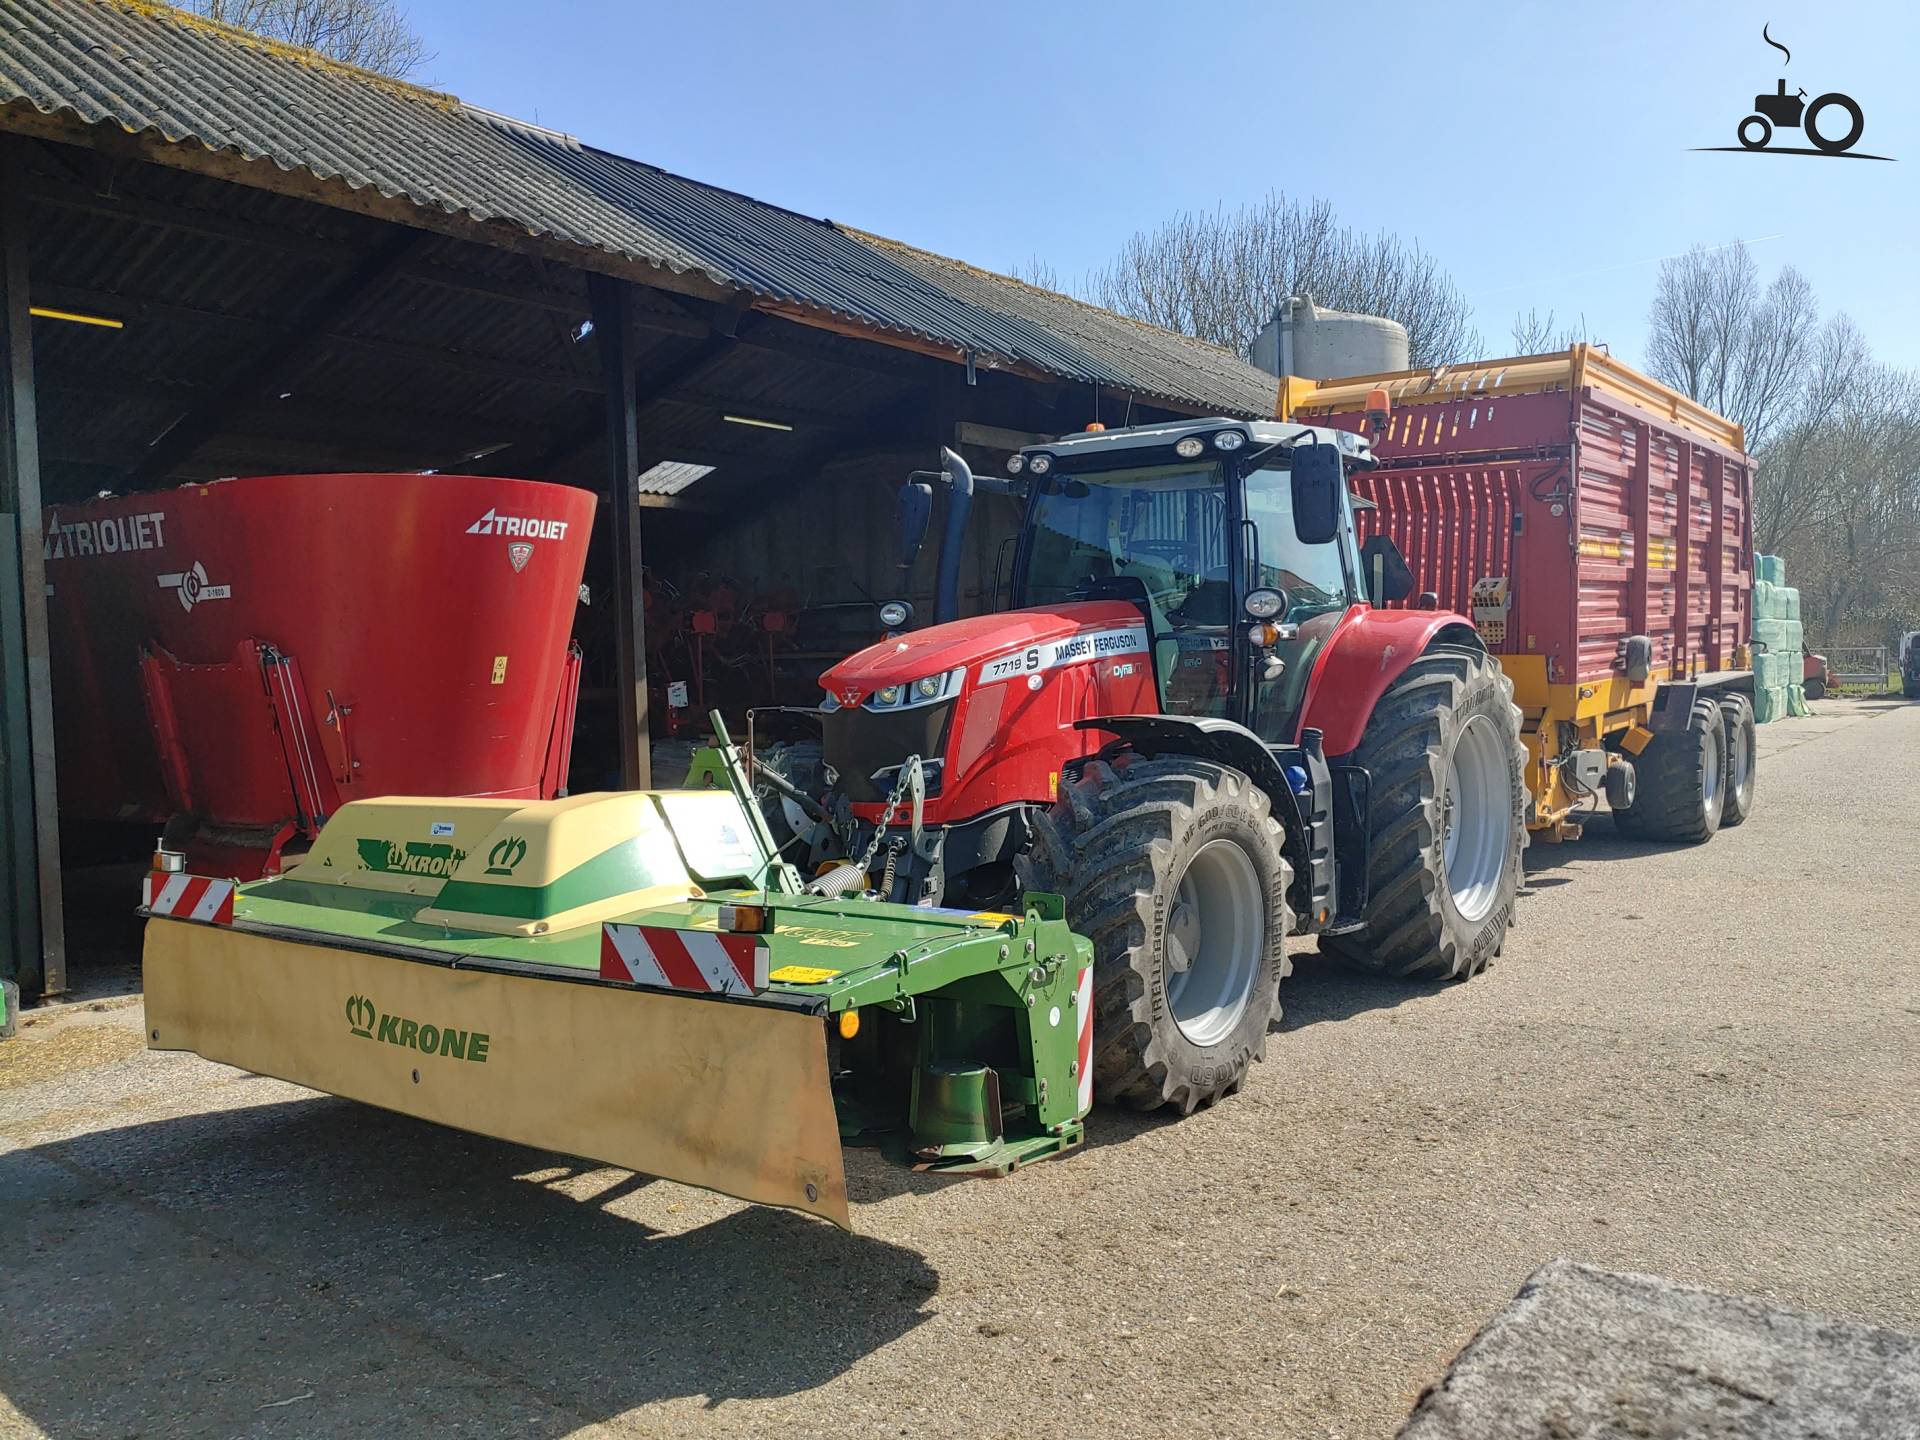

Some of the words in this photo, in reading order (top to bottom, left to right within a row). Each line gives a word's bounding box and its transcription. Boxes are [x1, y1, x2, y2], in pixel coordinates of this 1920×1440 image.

[61, 512, 166, 558] TRIOLIET
[494, 516, 568, 541] TRIOLIET
[993, 658, 1021, 676] 7719
[1026, 648, 1039, 671] S
[1055, 639, 1092, 661] MASSEY
[1094, 634, 1137, 652] FERGUSON
[404, 854, 464, 876] KRON
[1271, 866, 1284, 984] TRELLEBORG
[1151, 894, 1165, 1023] TRELLEBORG
[377, 1013, 490, 1063] KRONE
